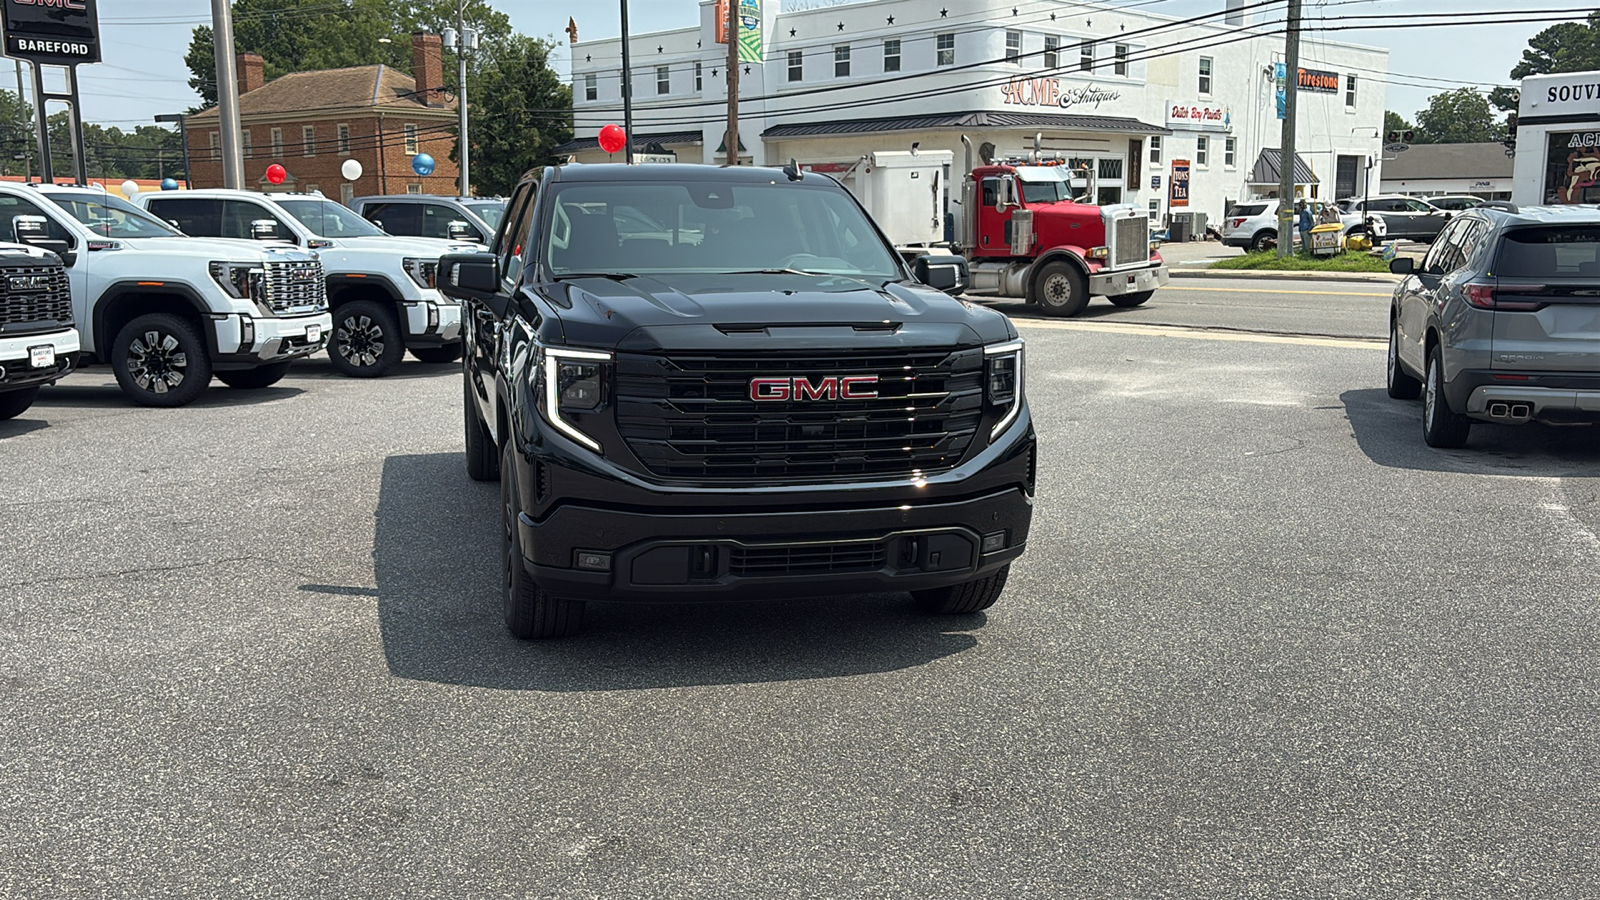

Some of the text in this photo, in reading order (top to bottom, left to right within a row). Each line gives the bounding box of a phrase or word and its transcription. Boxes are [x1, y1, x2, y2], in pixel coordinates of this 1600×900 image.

[18, 39, 88, 55] BAREFORD
[1297, 68, 1338, 89] Firestone
[1001, 75, 1060, 107] ACME
[1072, 81, 1121, 110] Antiques
[1171, 105, 1222, 122] Dutch Boy Paints
[1174, 186, 1187, 198] TEA
[750, 374, 879, 401] GMC
